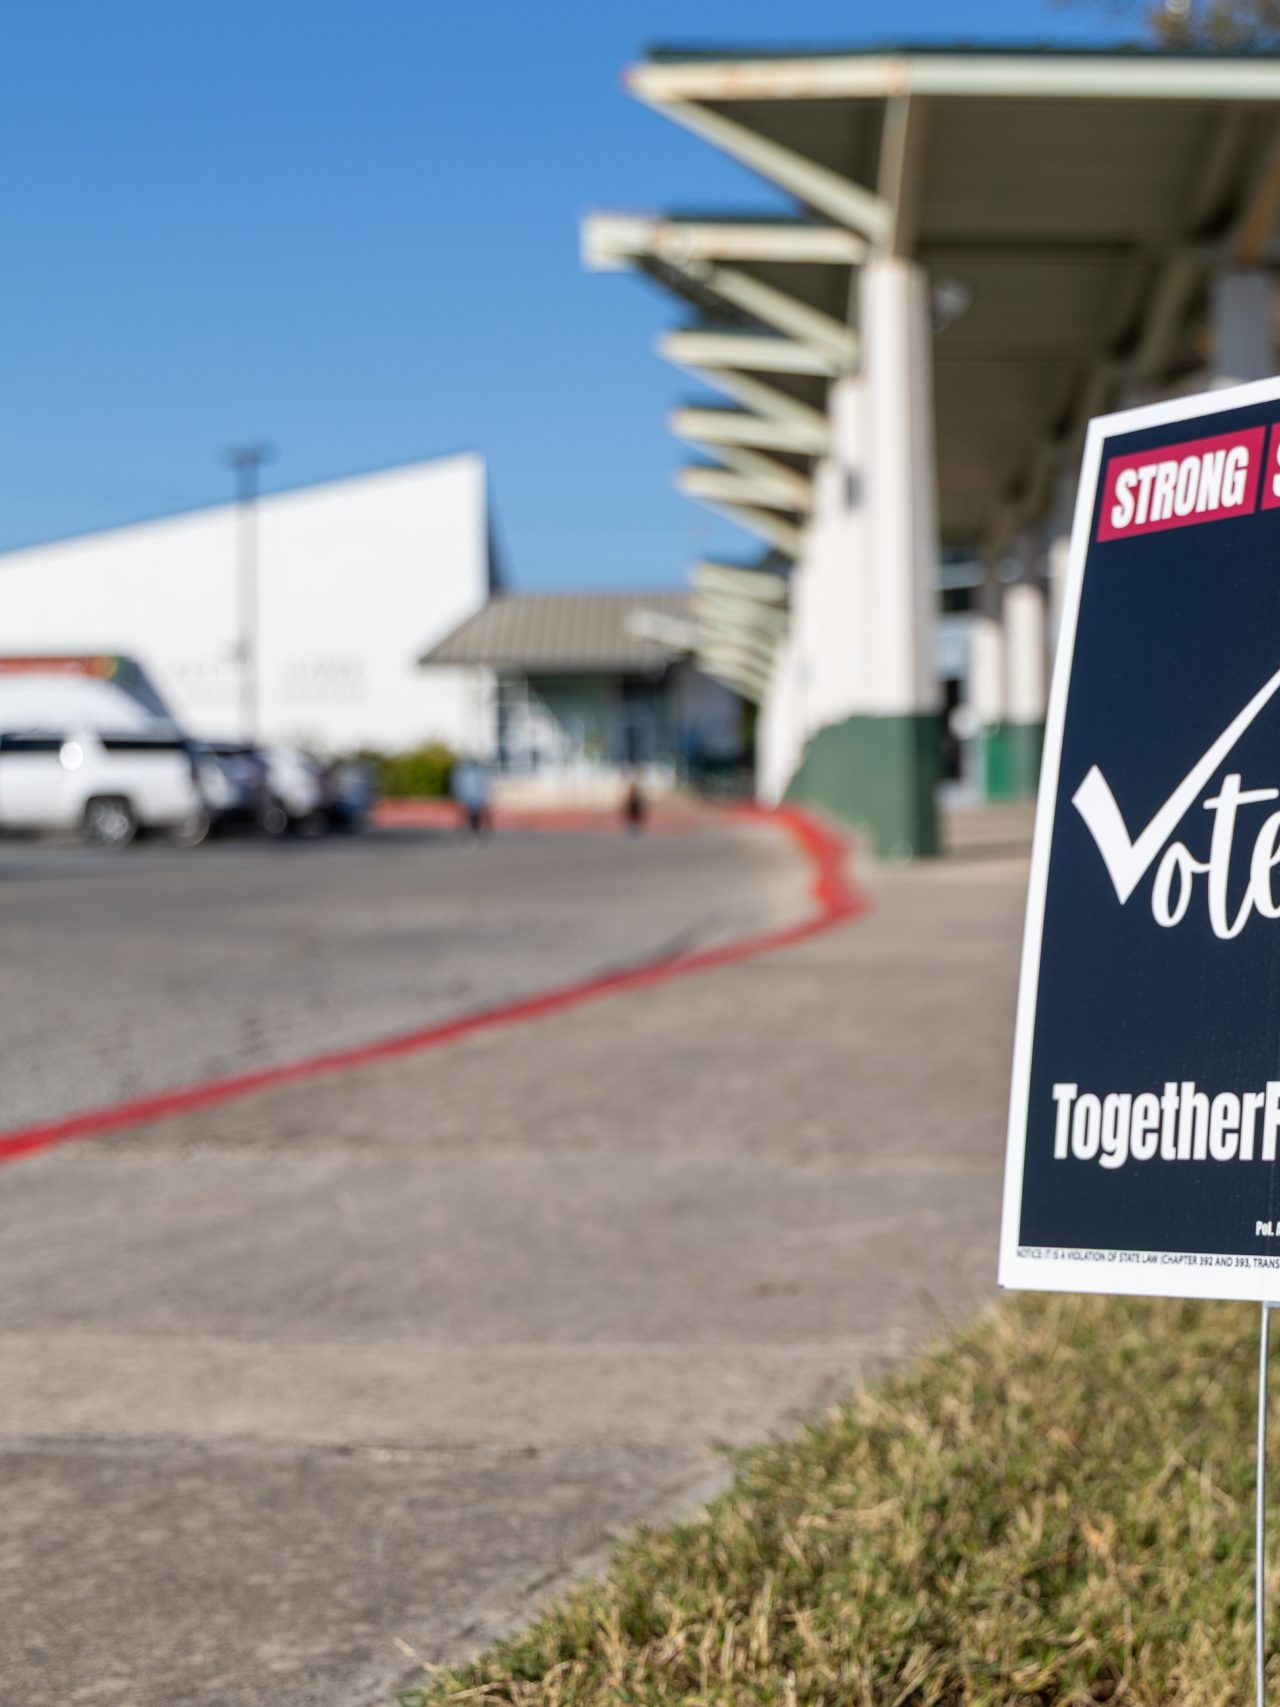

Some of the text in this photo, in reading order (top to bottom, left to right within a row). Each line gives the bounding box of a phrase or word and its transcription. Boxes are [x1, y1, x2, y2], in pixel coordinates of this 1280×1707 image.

[1110, 445, 1250, 530] STRONG
[1255, 1220, 1274, 1236] Pol.
[1068, 1251, 1105, 1261] VIOLATION
[1107, 1252, 1117, 1262] OF
[1119, 1253, 1139, 1263] STATE
[1142, 1254, 1157, 1264] LAW
[1160, 1254, 1197, 1265] (CHAPTER
[1199, 1256, 1213, 1266] 392
[1215, 1256, 1232, 1267] AND
[1235, 1257, 1250, 1268] 393,
